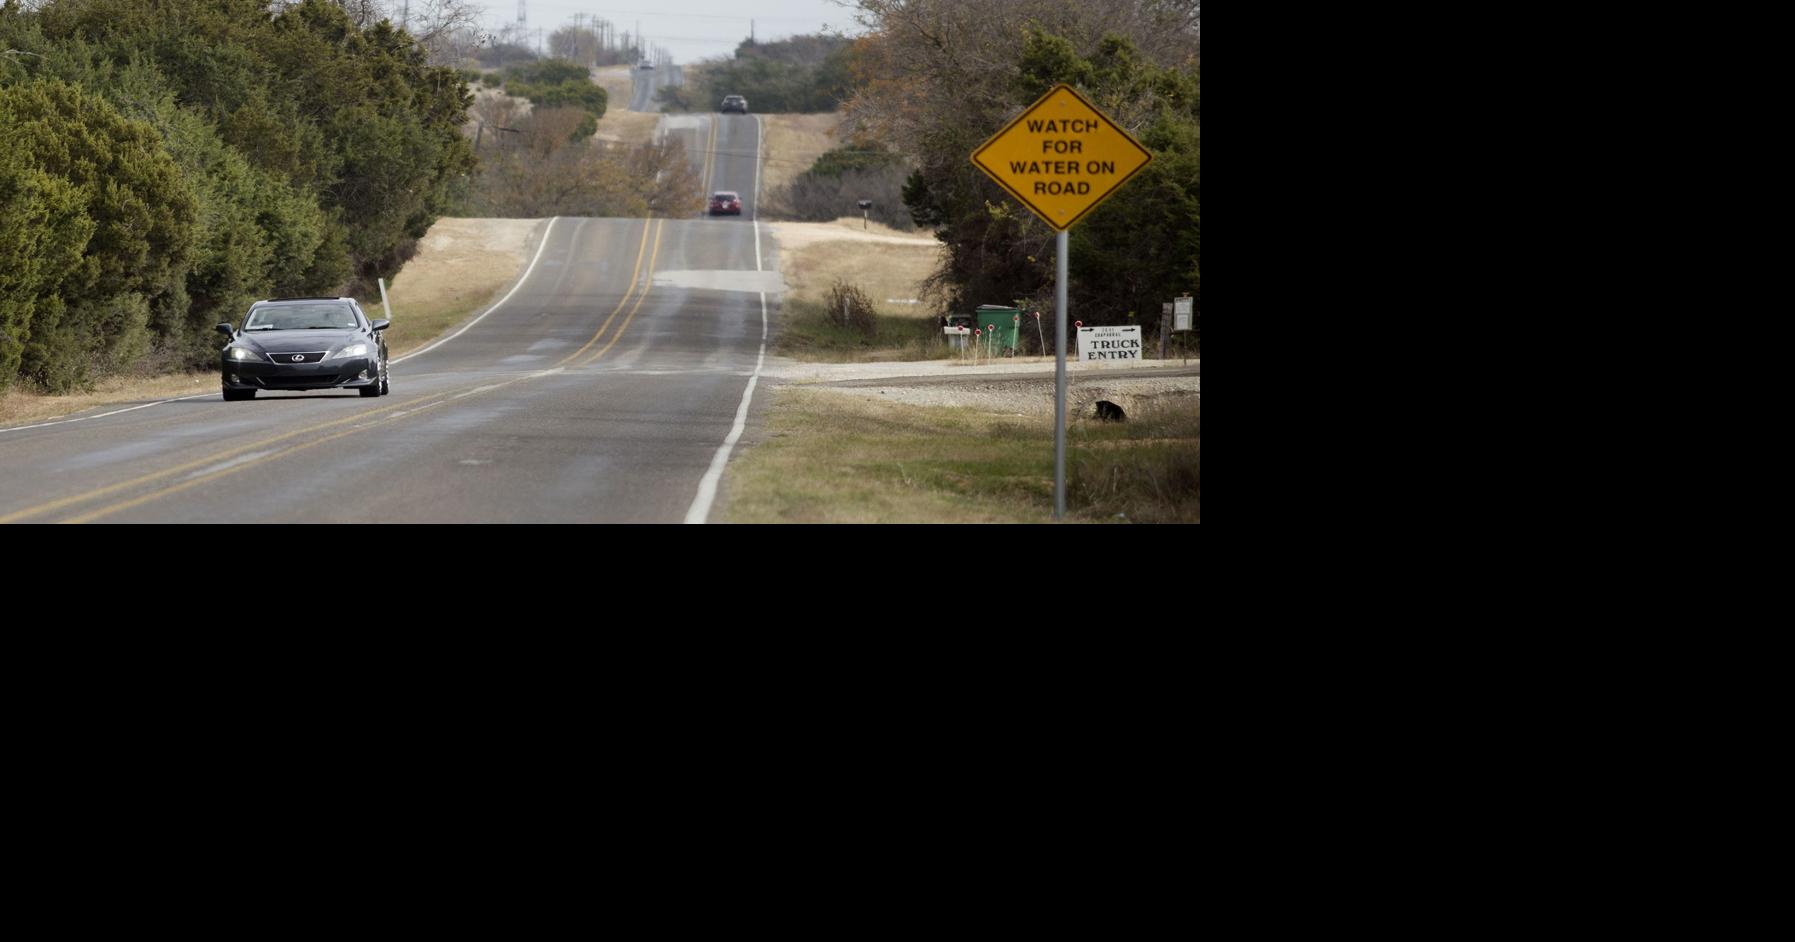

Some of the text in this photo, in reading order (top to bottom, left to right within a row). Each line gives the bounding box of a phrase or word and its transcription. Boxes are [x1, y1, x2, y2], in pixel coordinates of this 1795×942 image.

[1027, 119, 1099, 134] WATCH
[1042, 140, 1083, 154] FOR
[1009, 160, 1115, 175] WATER ON
[1034, 181, 1091, 196] ROAD
[1090, 339, 1140, 349] TRUCK
[1088, 350, 1138, 360] ENTRY
